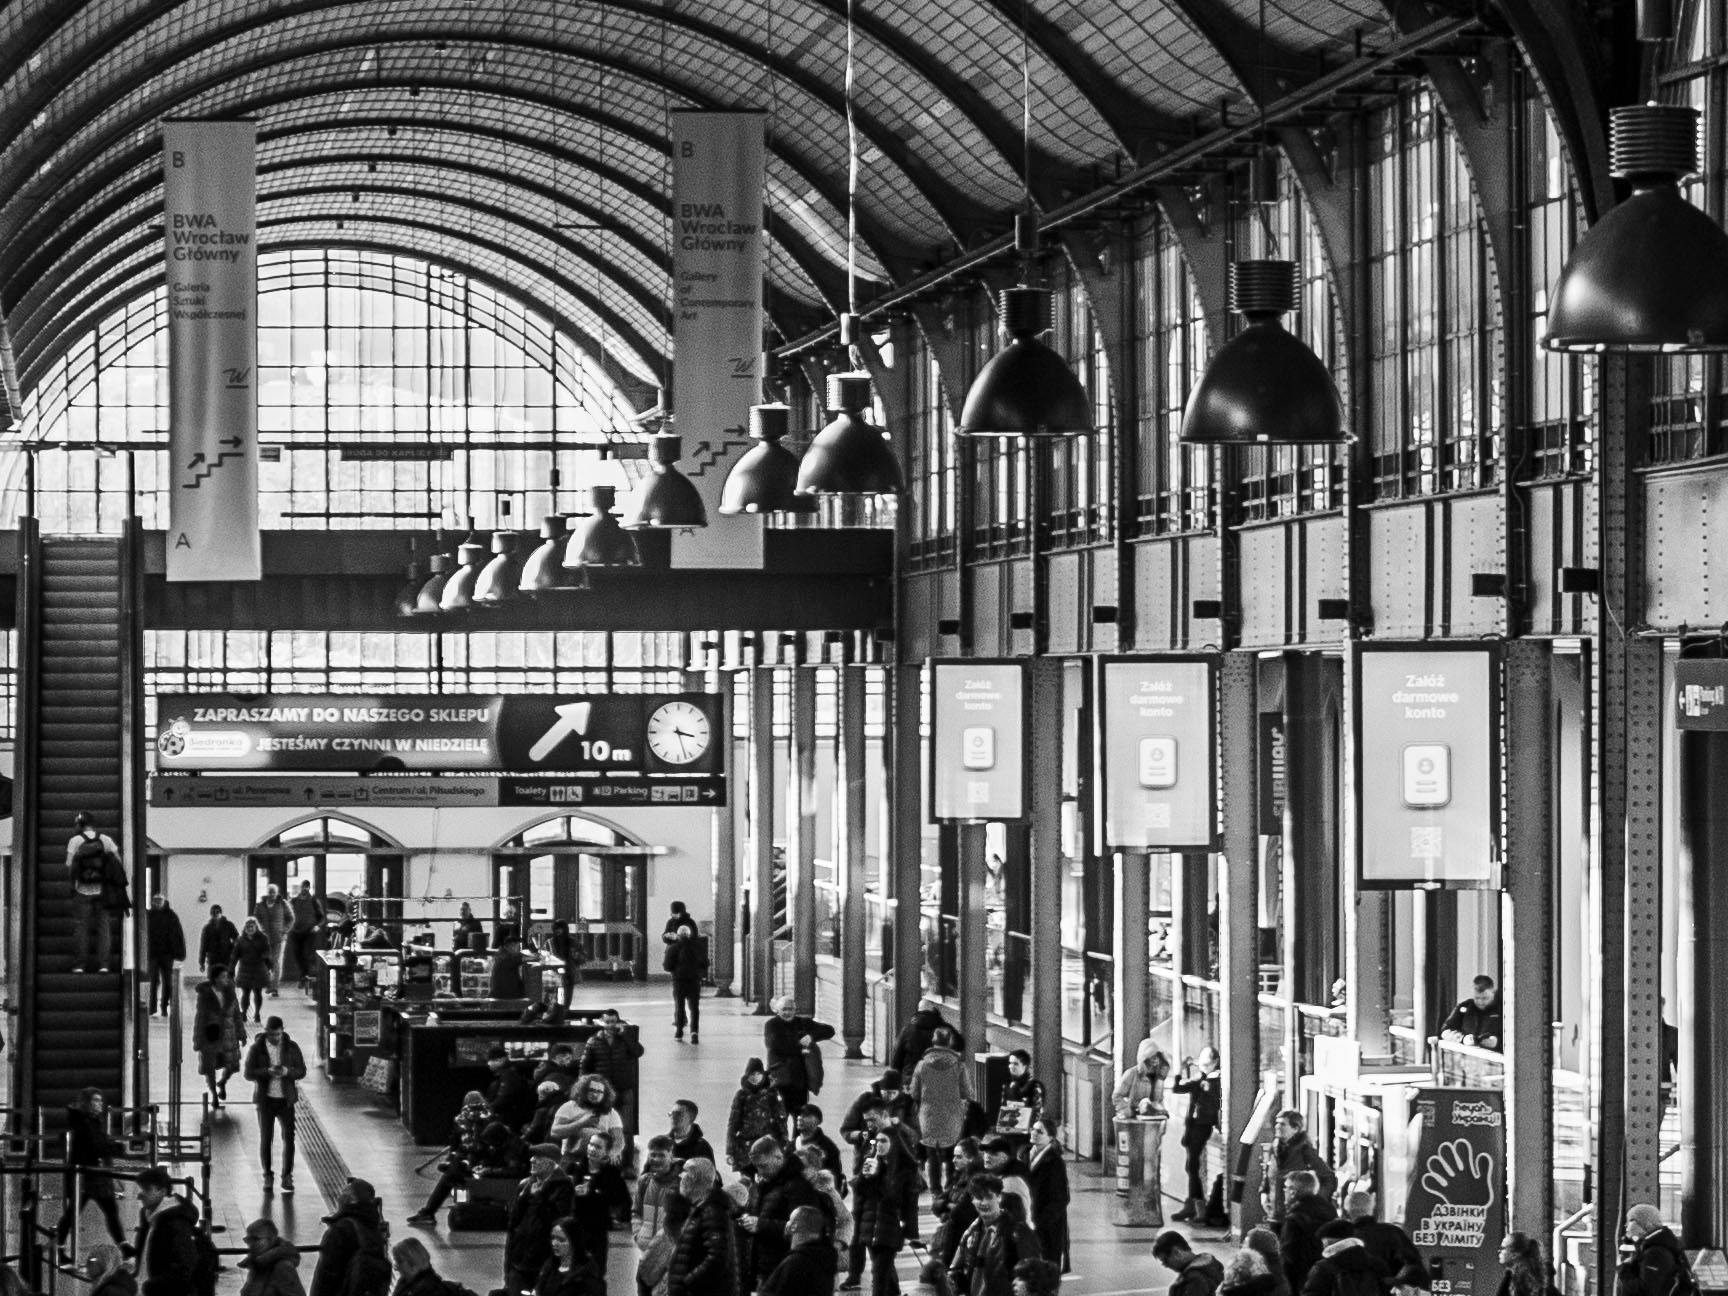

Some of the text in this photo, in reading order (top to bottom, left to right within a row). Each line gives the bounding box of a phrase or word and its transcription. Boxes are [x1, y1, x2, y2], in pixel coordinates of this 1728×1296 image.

[173, 150, 185, 168] B
[681, 204, 725, 218] BWA
[173, 213, 217, 228] BWA
[681, 220, 755, 235] Wrocław
[173, 229, 250, 245] Wrocław
[681, 236, 745, 253] Główny
[173, 245, 240, 264] Główny
[175, 532, 192, 550] A
[1404, 673, 1446, 688] Załóż
[1392, 690, 1459, 704] darmowe
[193, 707, 490, 722] ZAPRASZAMY DO NASZEGO SKLEPU
[1139, 707, 1174, 717] konto
[1404, 706, 1446, 719] konto
[255, 734, 490, 755] JESTEŚMY CZYNNI W NIEDZIELĘ
[372, 785, 411, 795] Centrum
[1432, 1205, 1485, 1217] ДЗВІНКИ
[1433, 1218, 1483, 1232] УКРАЇНУ
[1414, 1232, 1483, 1245] БЕЗ ЛІМІТУ
